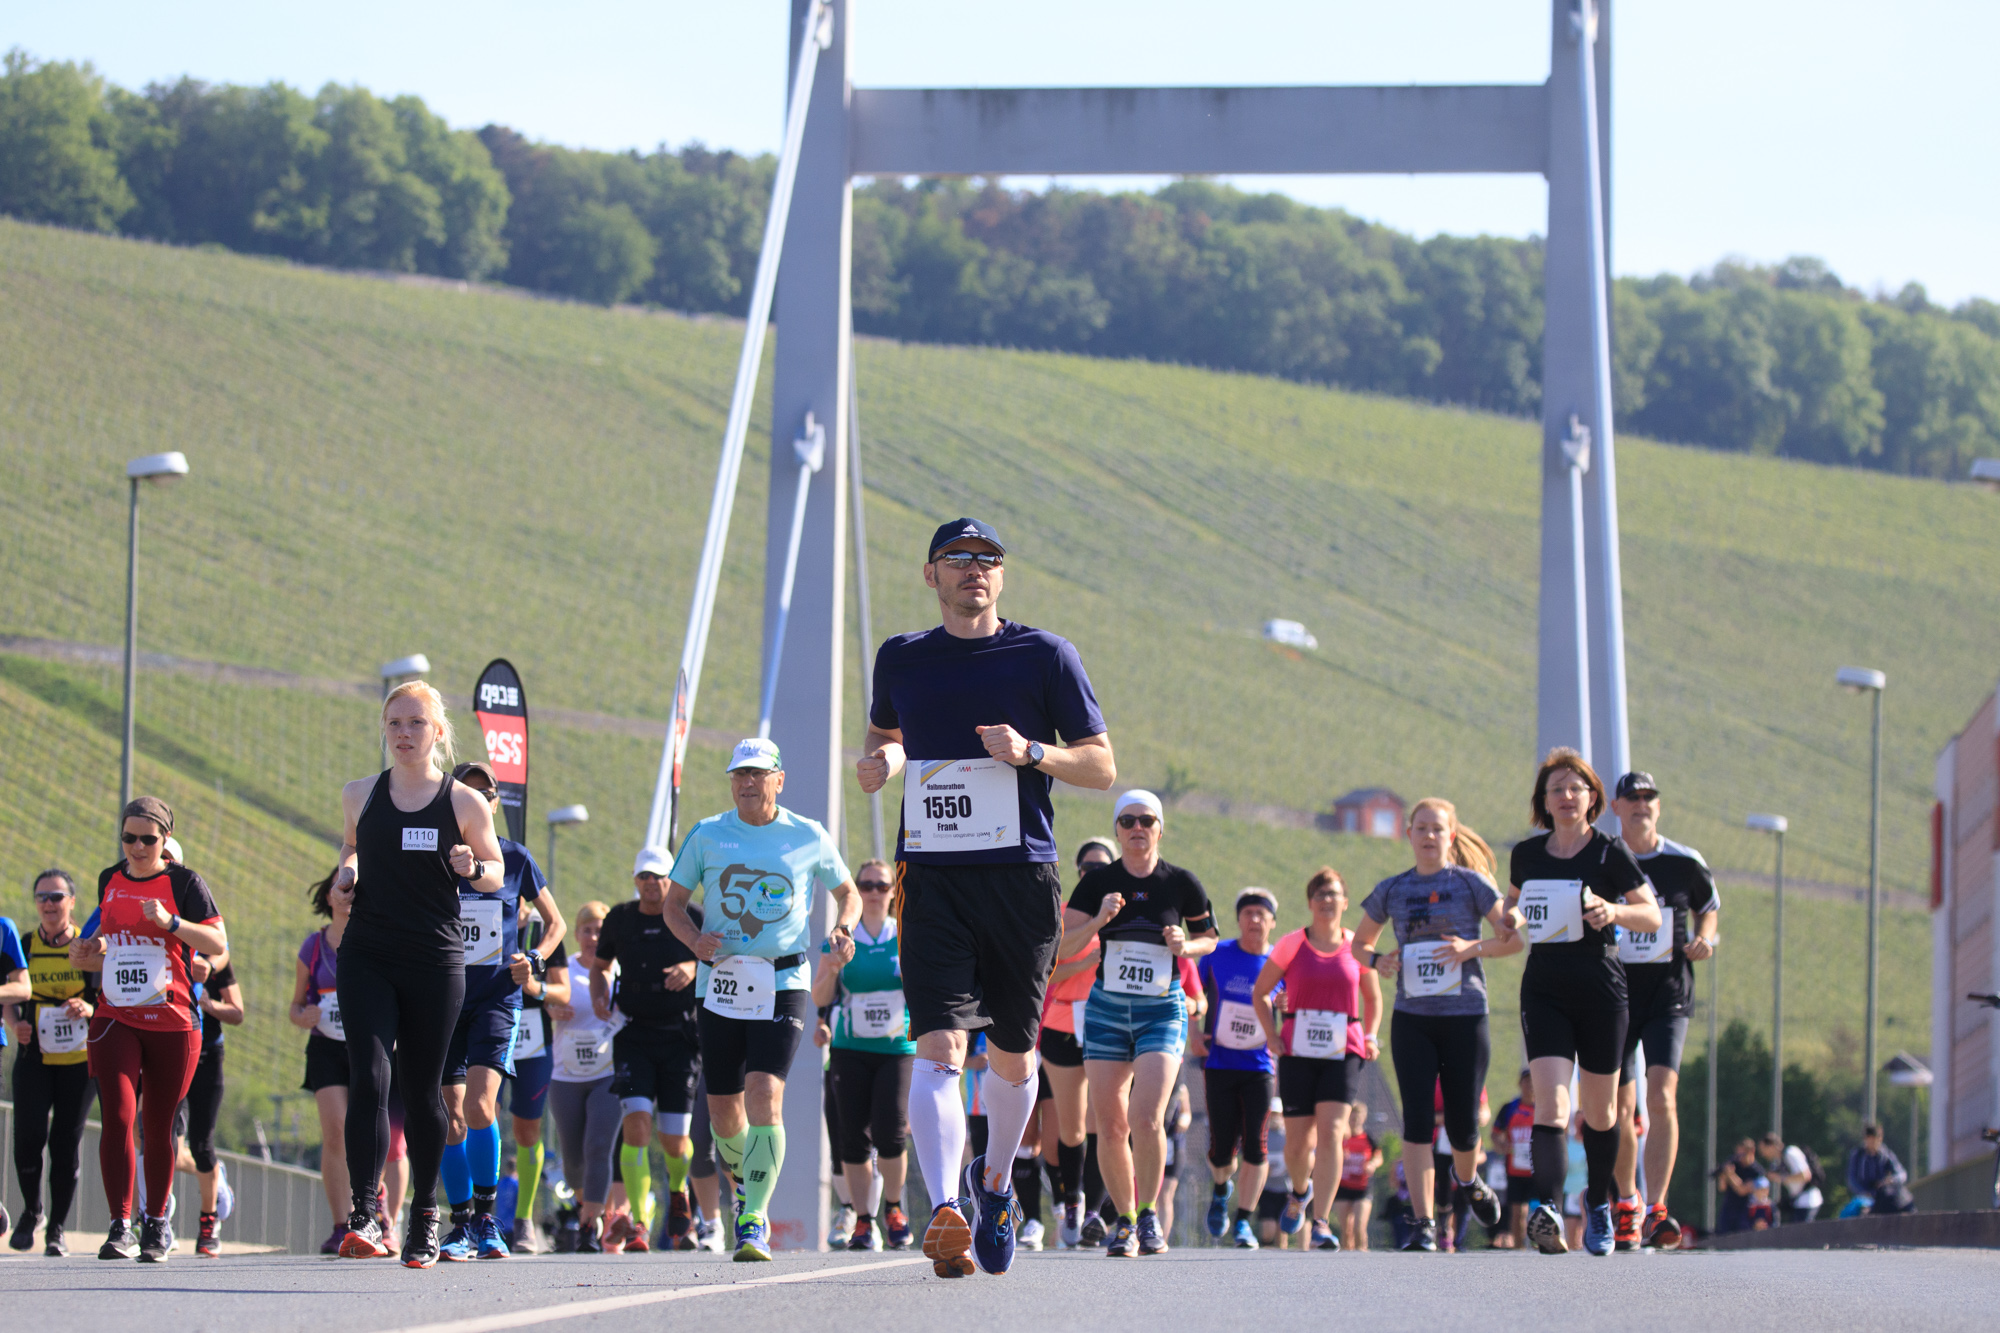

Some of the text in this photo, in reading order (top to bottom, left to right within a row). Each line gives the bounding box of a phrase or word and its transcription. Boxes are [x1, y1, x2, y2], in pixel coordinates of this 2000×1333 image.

[923, 795, 972, 819] 1550
[937, 822, 958, 831] Frank
[407, 830, 434, 841] 1110
[1524, 904, 1548, 920] 1761
[1628, 932, 1658, 944] 1278
[115, 968, 148, 985] 1945
[1119, 964, 1154, 984] 2419
[1417, 962, 1444, 977] 1279
[714, 978, 738, 996] 322
[864, 1009, 890, 1021] 1025
[54, 1024, 72, 1037] 311
[1307, 1029, 1333, 1042] 1203
